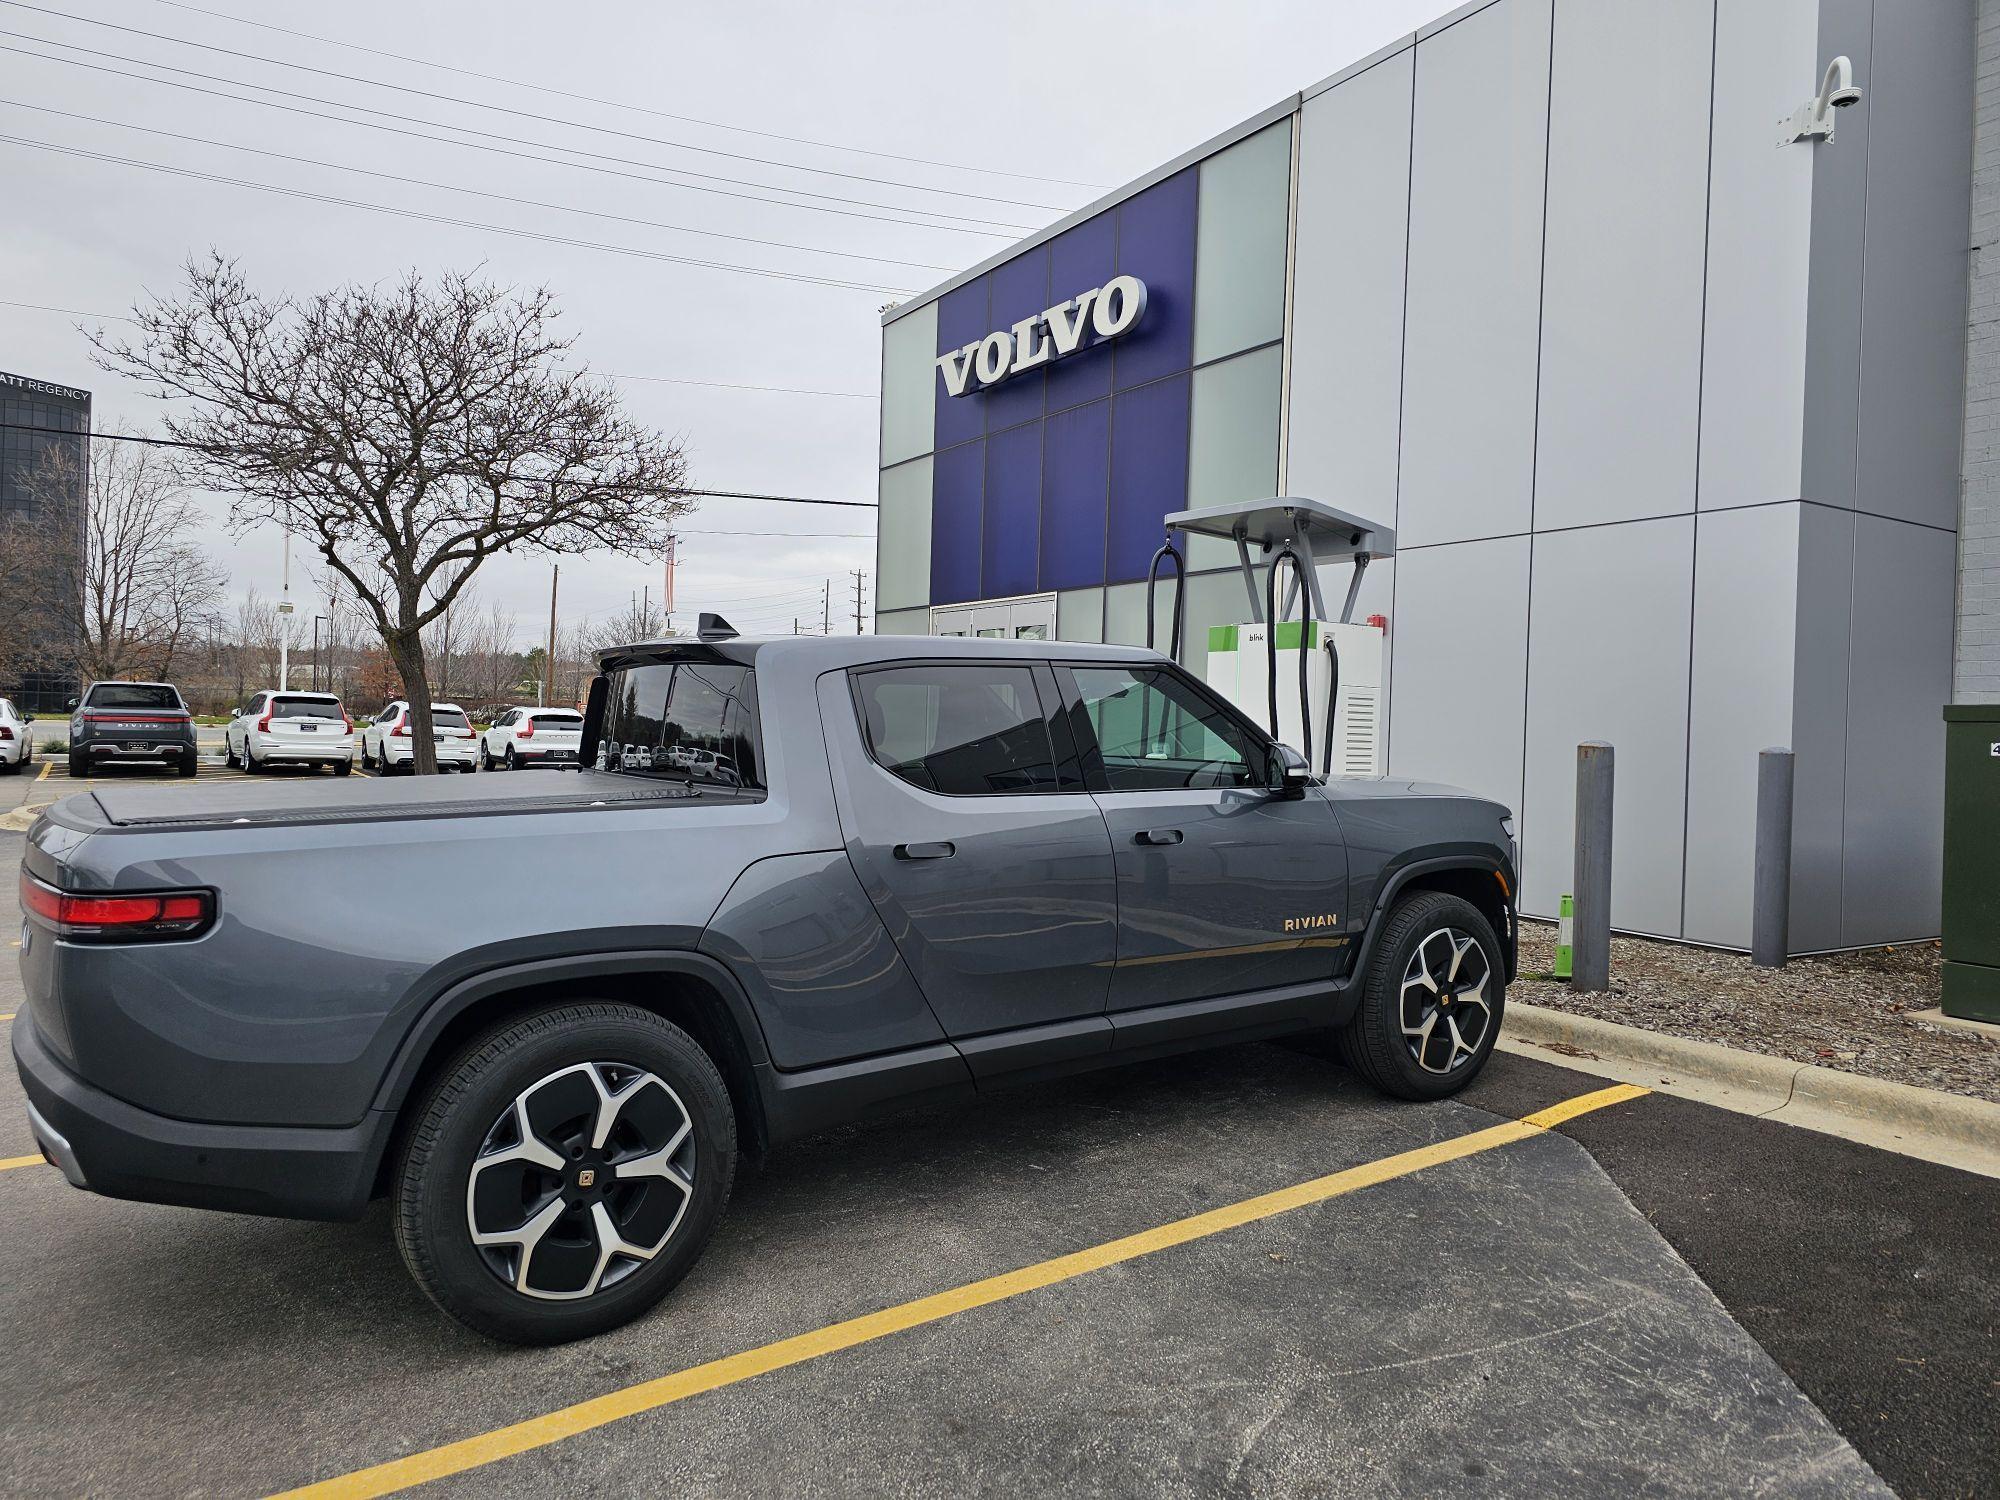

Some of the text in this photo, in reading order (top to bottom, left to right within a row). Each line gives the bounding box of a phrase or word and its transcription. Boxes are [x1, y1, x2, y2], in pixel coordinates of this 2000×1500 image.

[936, 275, 1147, 398] VOLVO
[28, 381, 89, 401] REGENCY
[1249, 633, 1264, 642] blink
[1284, 914, 1337, 932] RIVIAN
